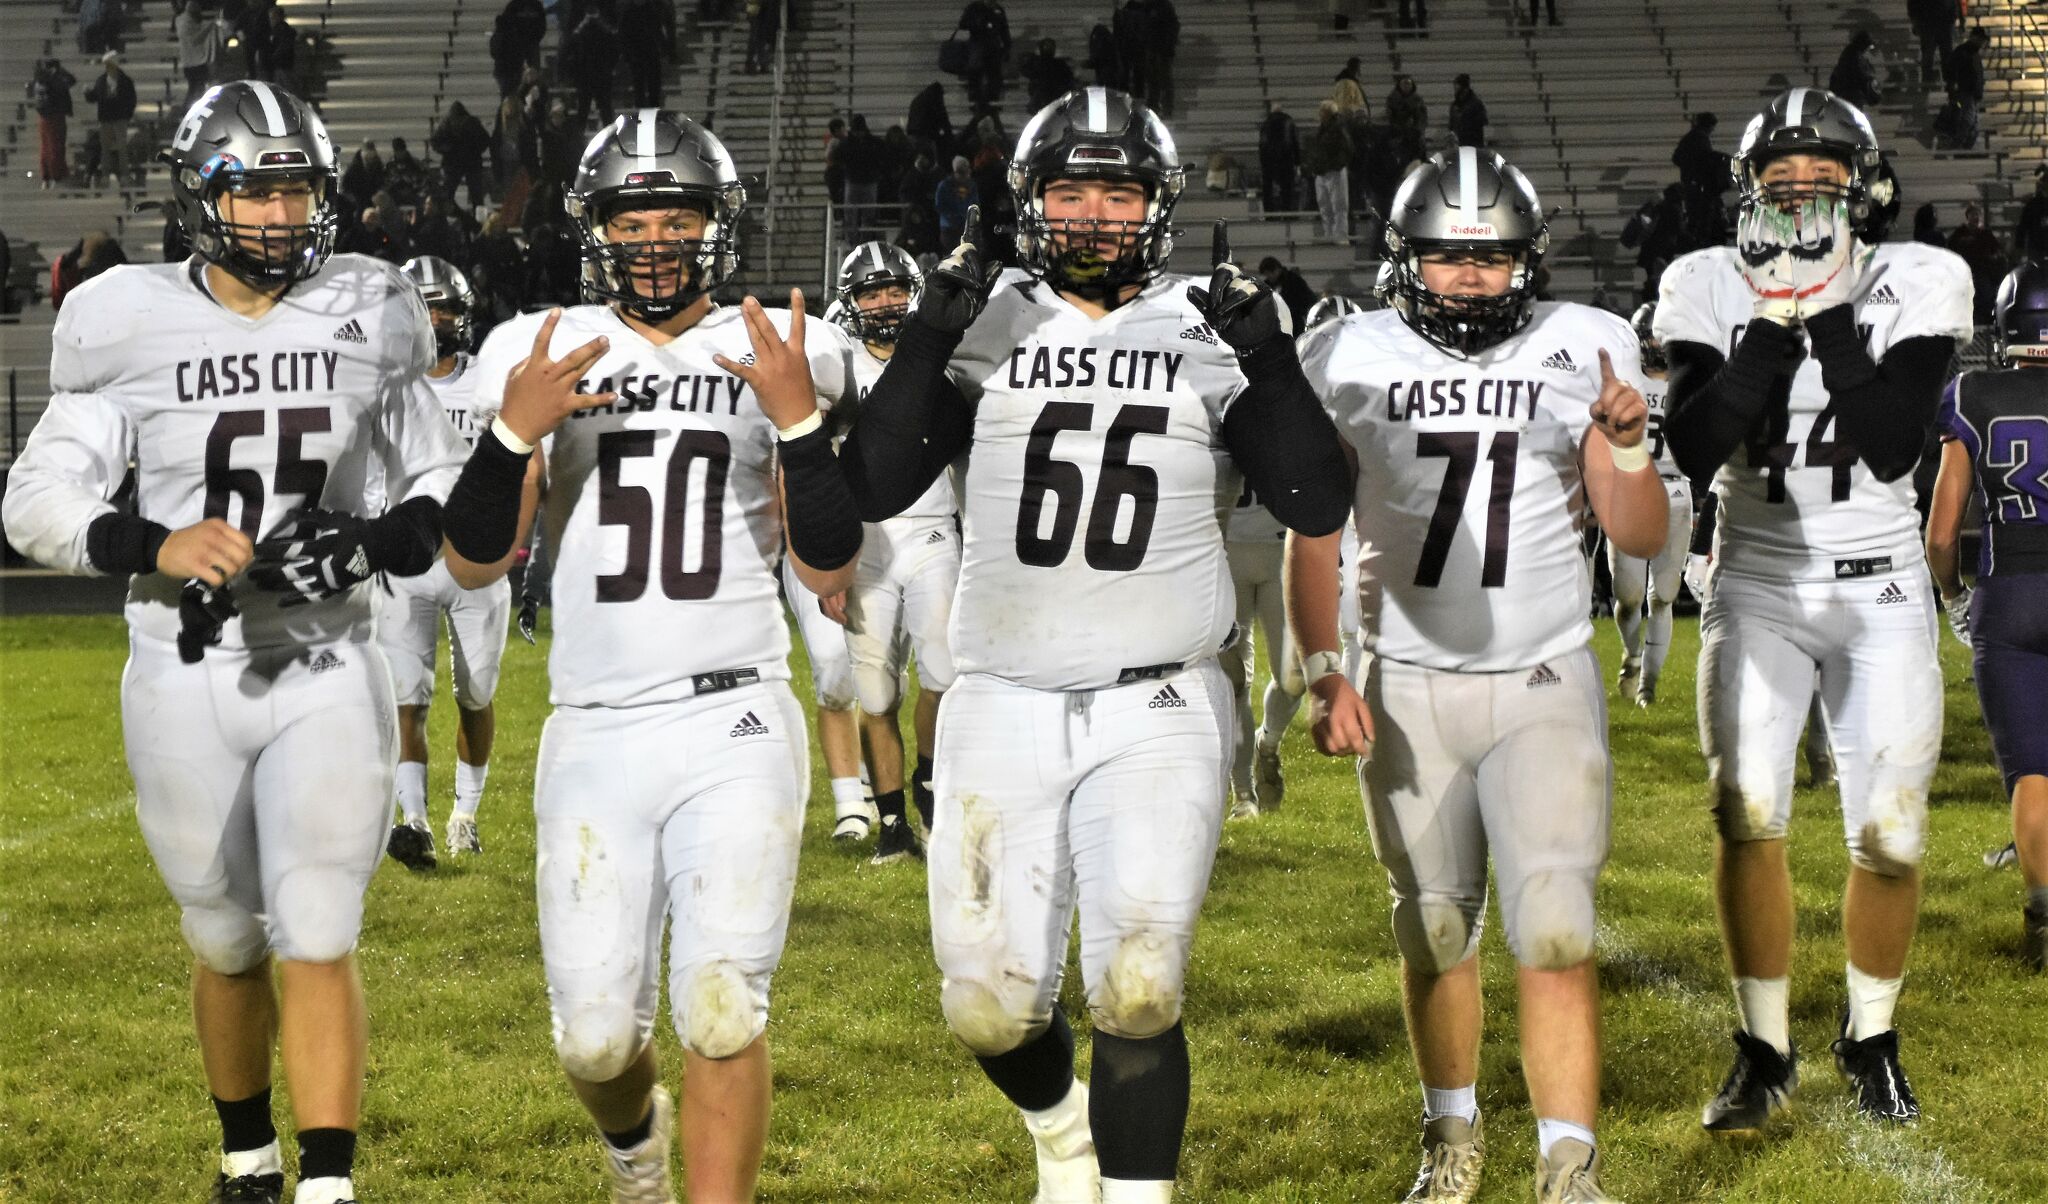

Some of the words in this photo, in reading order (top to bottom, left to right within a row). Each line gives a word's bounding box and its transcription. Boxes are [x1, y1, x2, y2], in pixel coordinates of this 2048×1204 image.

[1450, 226, 1491, 235] Riddell
[333, 331, 368, 344] adidas
[1179, 332, 1218, 346] adidas
[176, 353, 260, 403] CASS
[272, 352, 338, 393] CITY
[1009, 346, 1097, 389] CASS
[1108, 350, 1184, 392] CITY
[1541, 359, 1577, 373] adidas
[670, 374, 746, 415] CITY
[1388, 379, 1466, 422] CASS
[1477, 380, 1544, 421] CITY
[203, 407, 331, 545] 65
[1016, 401, 1170, 572] 66
[596, 429, 730, 603] 50
[1413, 431, 1519, 588] 71
[1876, 594, 1907, 605] adidas
[1148, 698, 1187, 708] adidas
[730, 725, 769, 737] adidas
